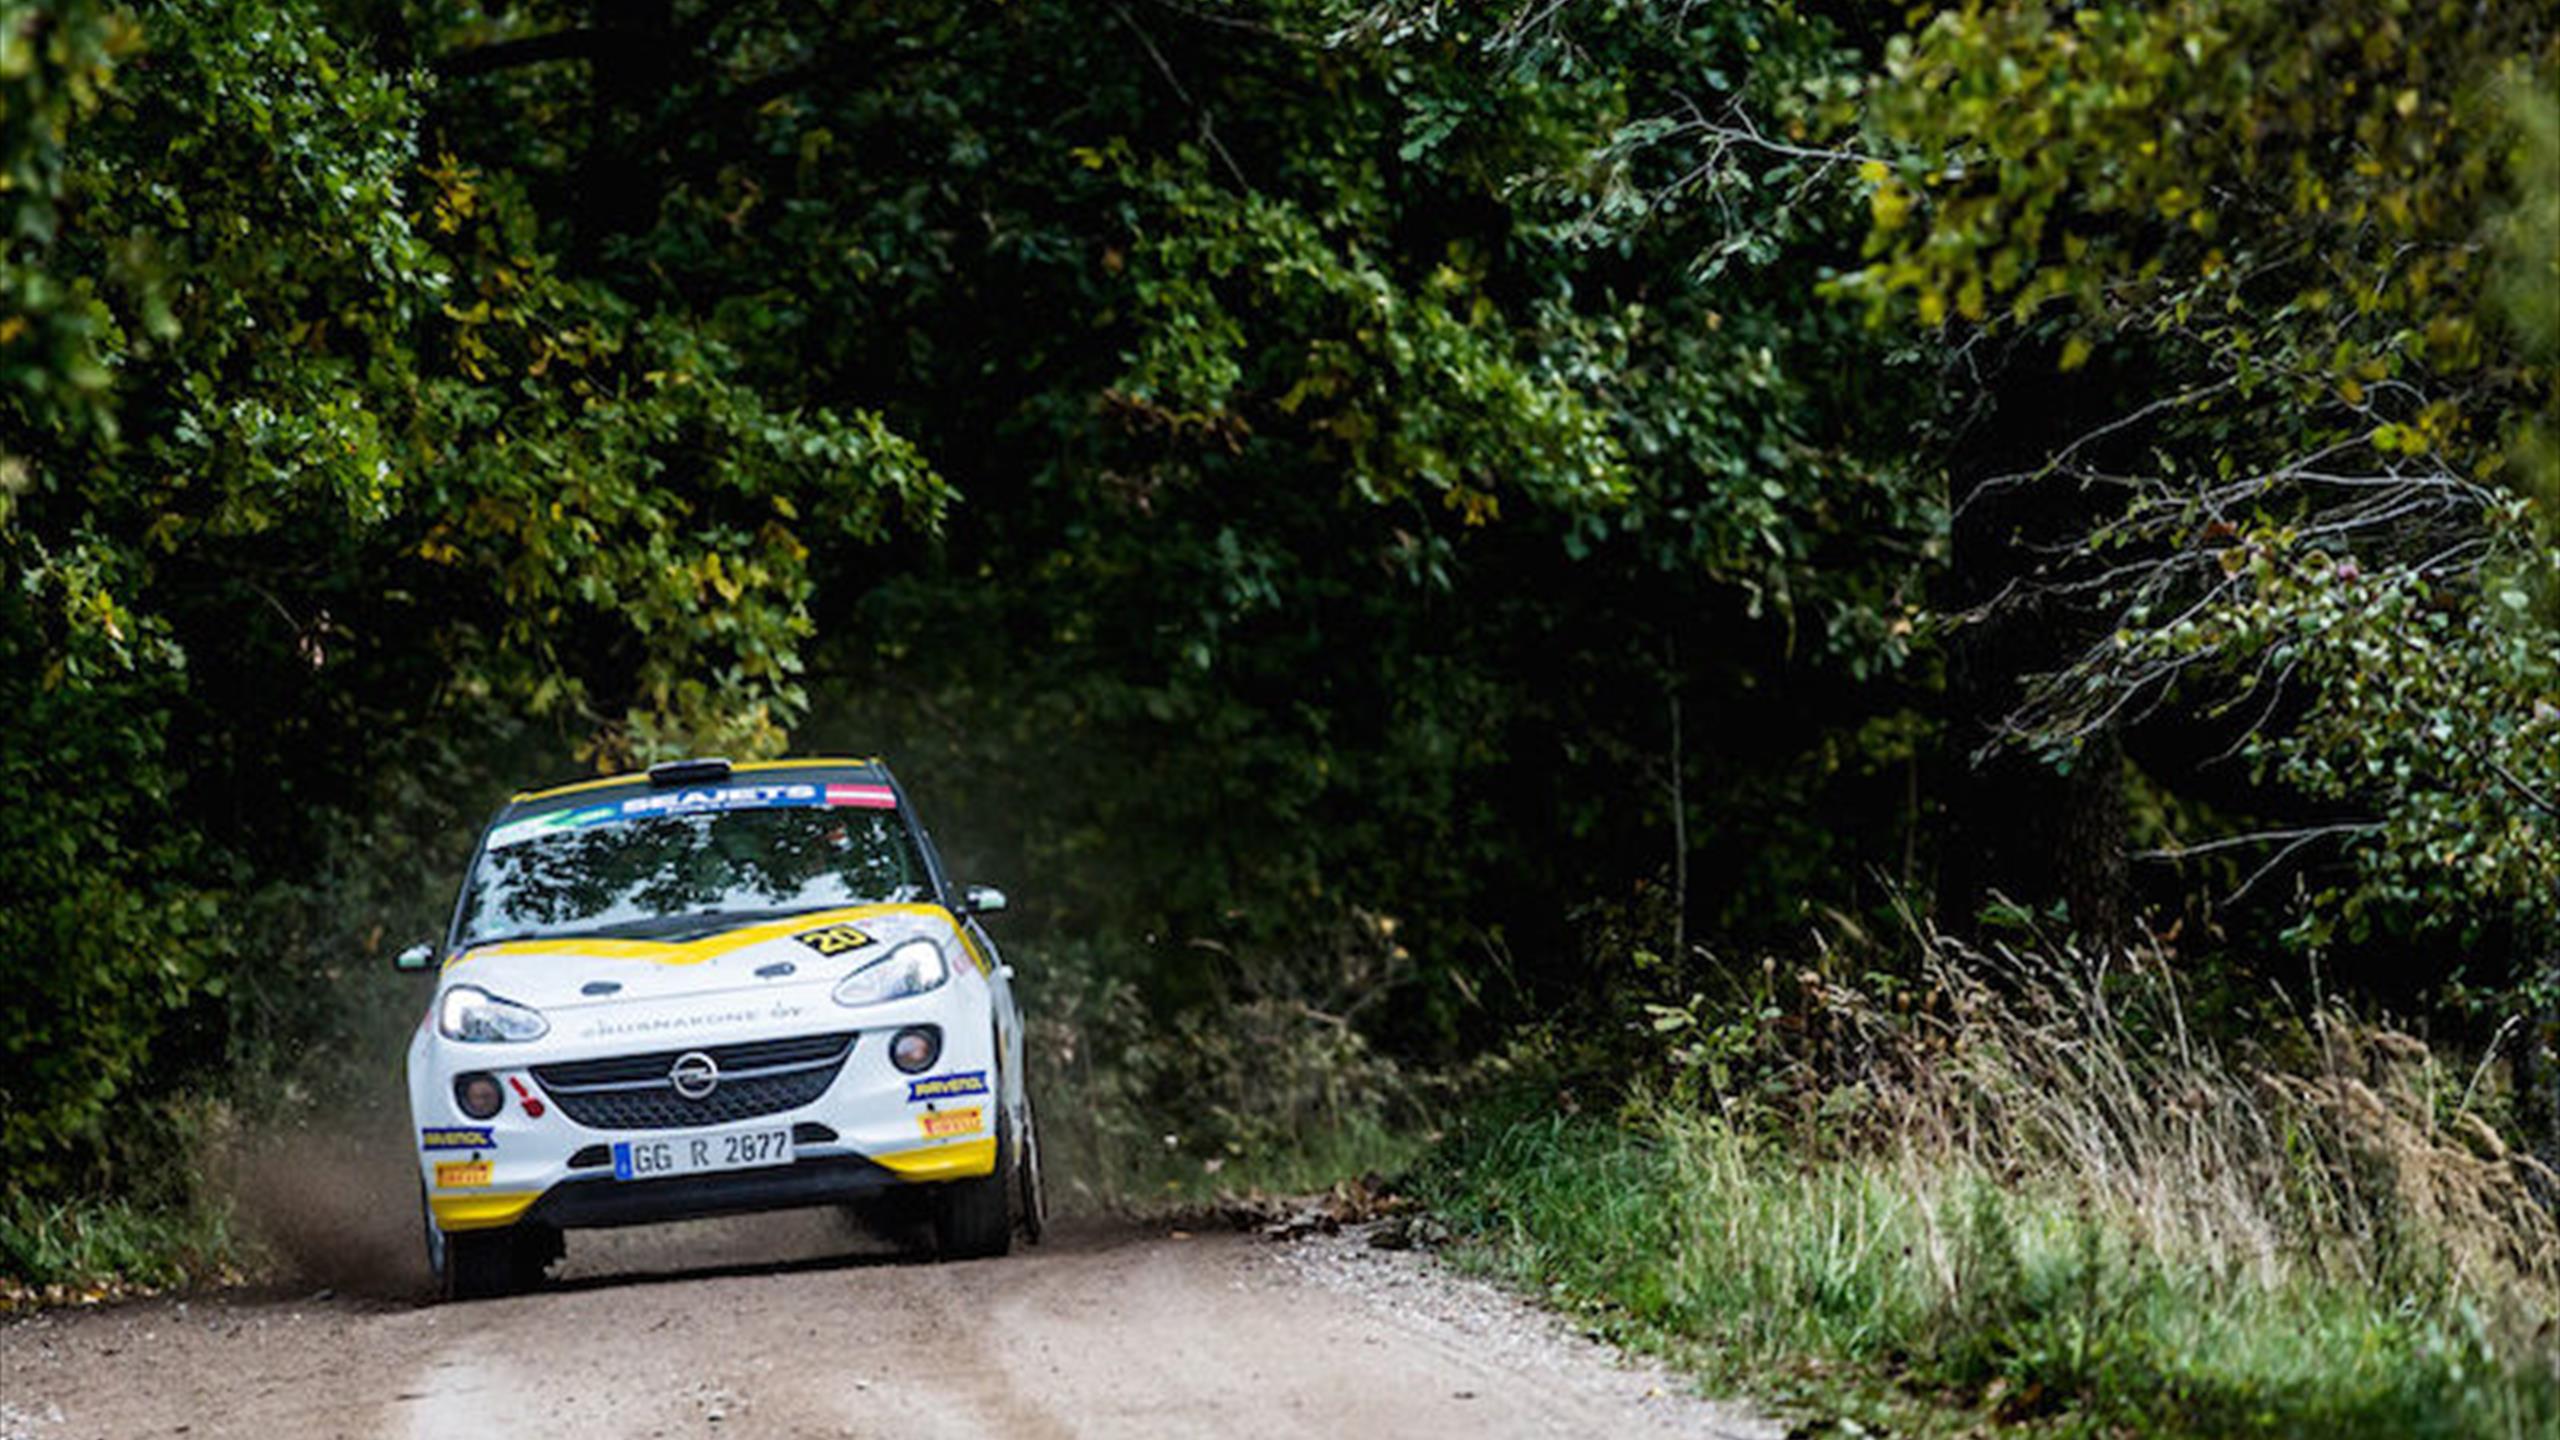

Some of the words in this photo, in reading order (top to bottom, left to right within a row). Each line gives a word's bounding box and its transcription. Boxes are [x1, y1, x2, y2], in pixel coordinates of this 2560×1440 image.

[622, 785, 815, 812] SEAJETS
[805, 926, 867, 953] 20
[635, 1144, 672, 1173] GG
[692, 1140, 710, 1167] R
